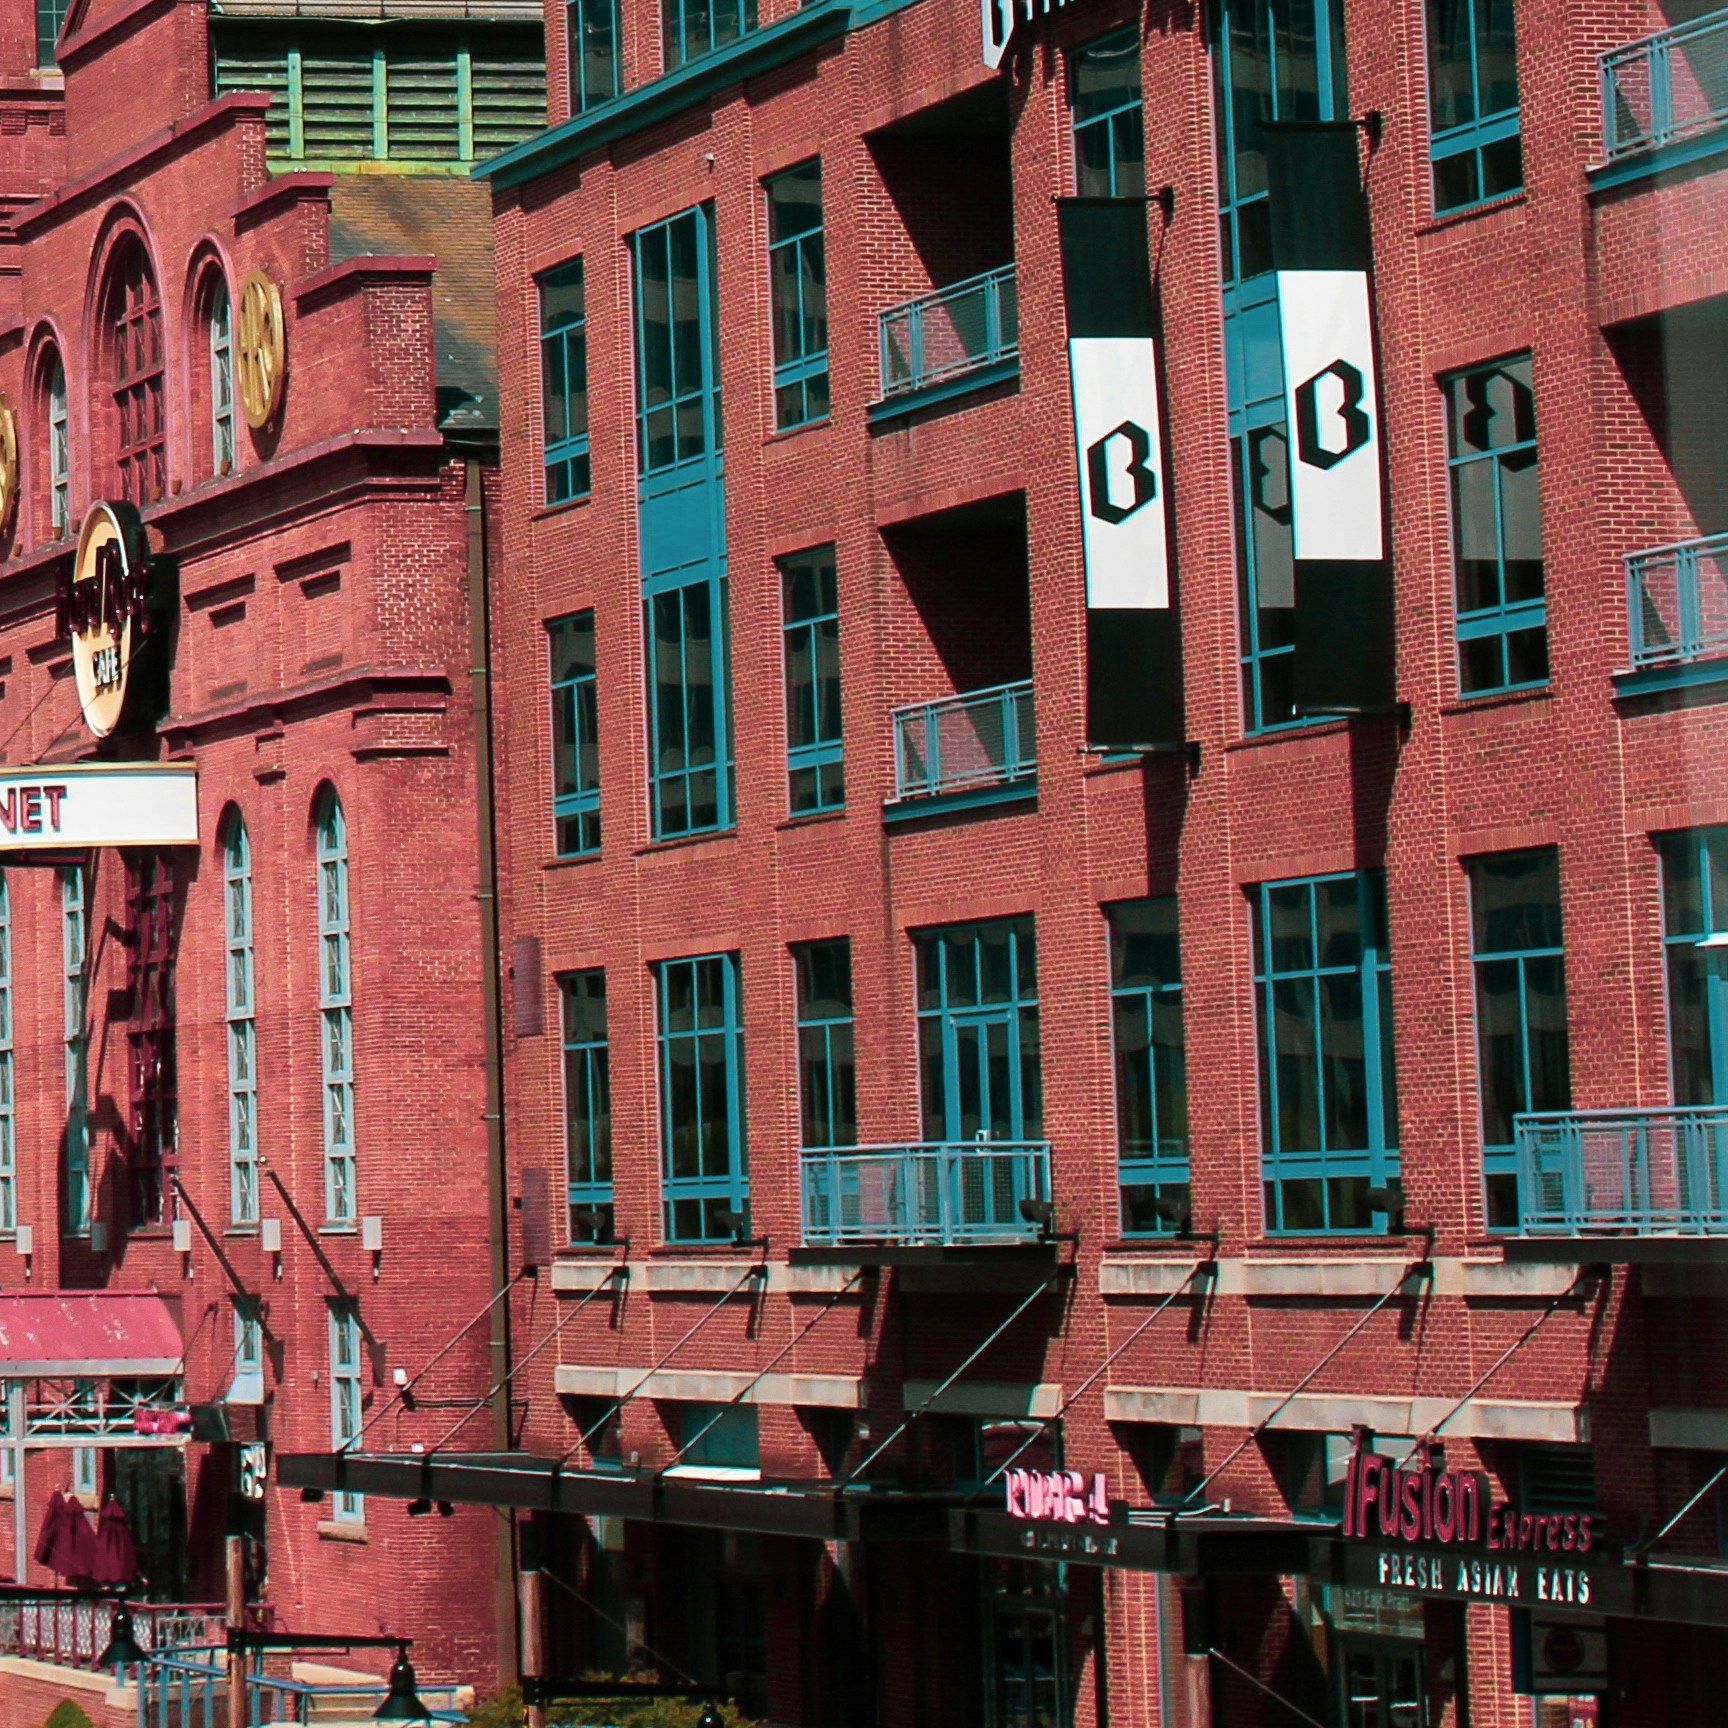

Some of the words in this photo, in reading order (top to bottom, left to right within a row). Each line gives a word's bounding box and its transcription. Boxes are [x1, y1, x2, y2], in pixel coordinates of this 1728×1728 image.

[1486, 1502, 1593, 1552] Express
[1378, 1553, 1443, 1590] FRESH
[1456, 1560, 1519, 1597] ASIAN
[1537, 1567, 1590, 1605] EATS
